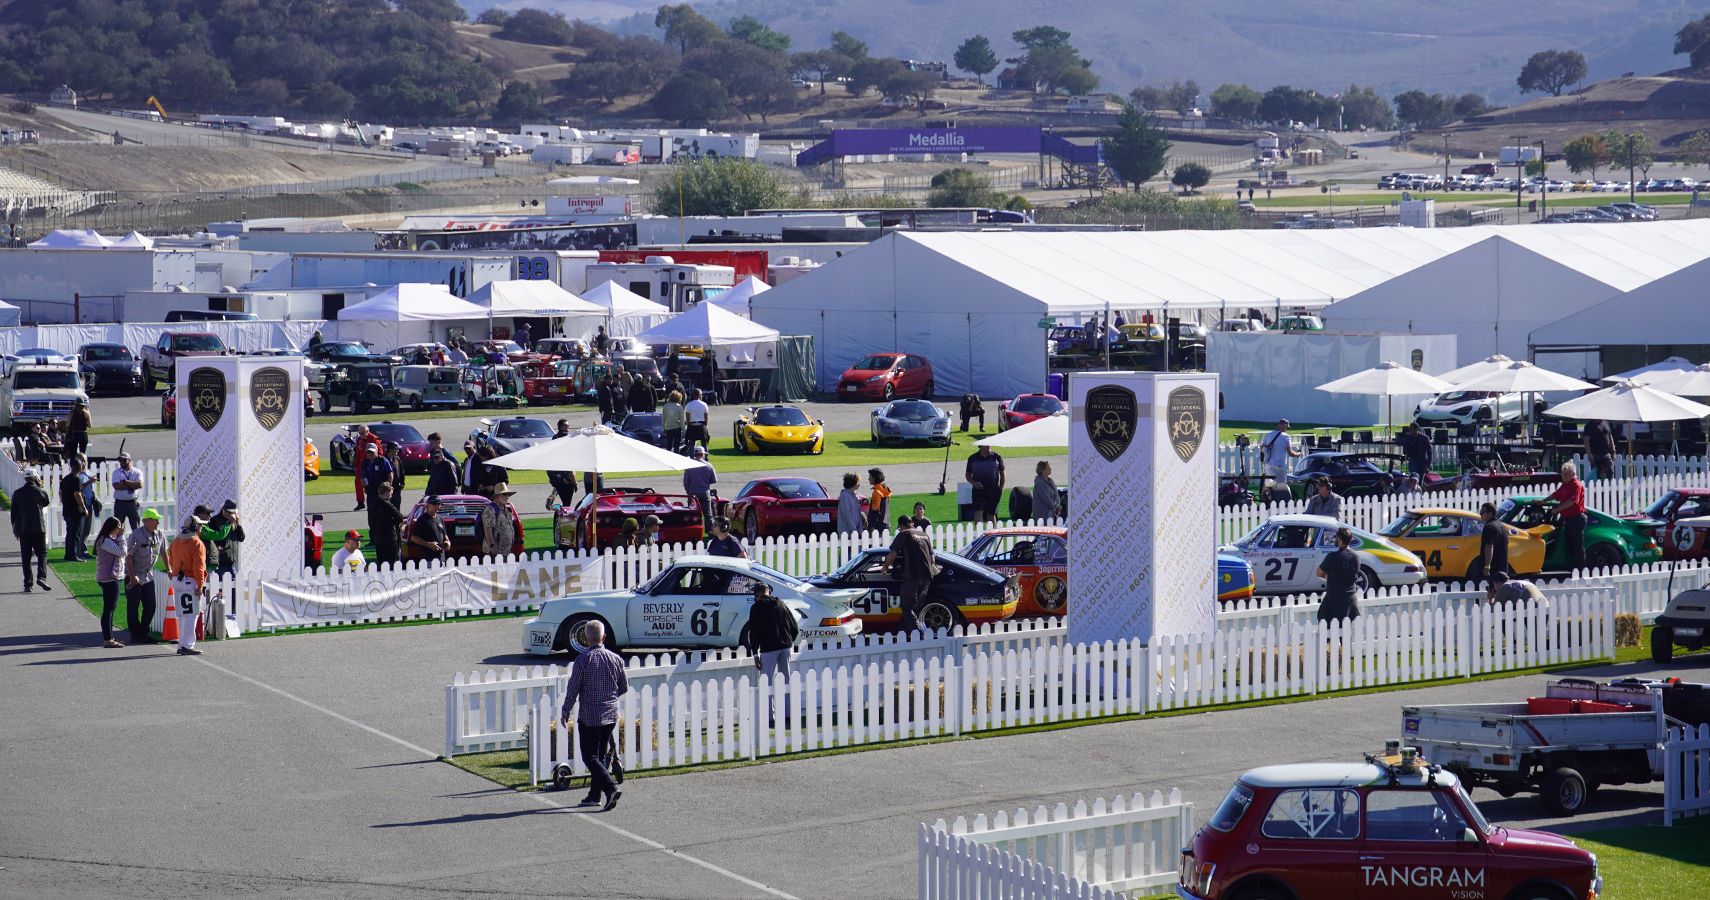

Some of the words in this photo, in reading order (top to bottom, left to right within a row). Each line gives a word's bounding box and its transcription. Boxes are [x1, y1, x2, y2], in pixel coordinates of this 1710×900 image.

[909, 132, 965, 146] Medallia
[568, 196, 604, 209] Intrepid
[1264, 557, 1300, 581] 27
[288, 572, 476, 618] VELOCITY
[491, 564, 583, 601] LANE
[181, 593, 193, 614] 5
[643, 602, 685, 614] BEVERLY
[651, 622, 676, 630] AUDI
[690, 608, 722, 637] 61
[1361, 866, 1485, 886] TANGRAM
[1451, 890, 1484, 899] VISION
